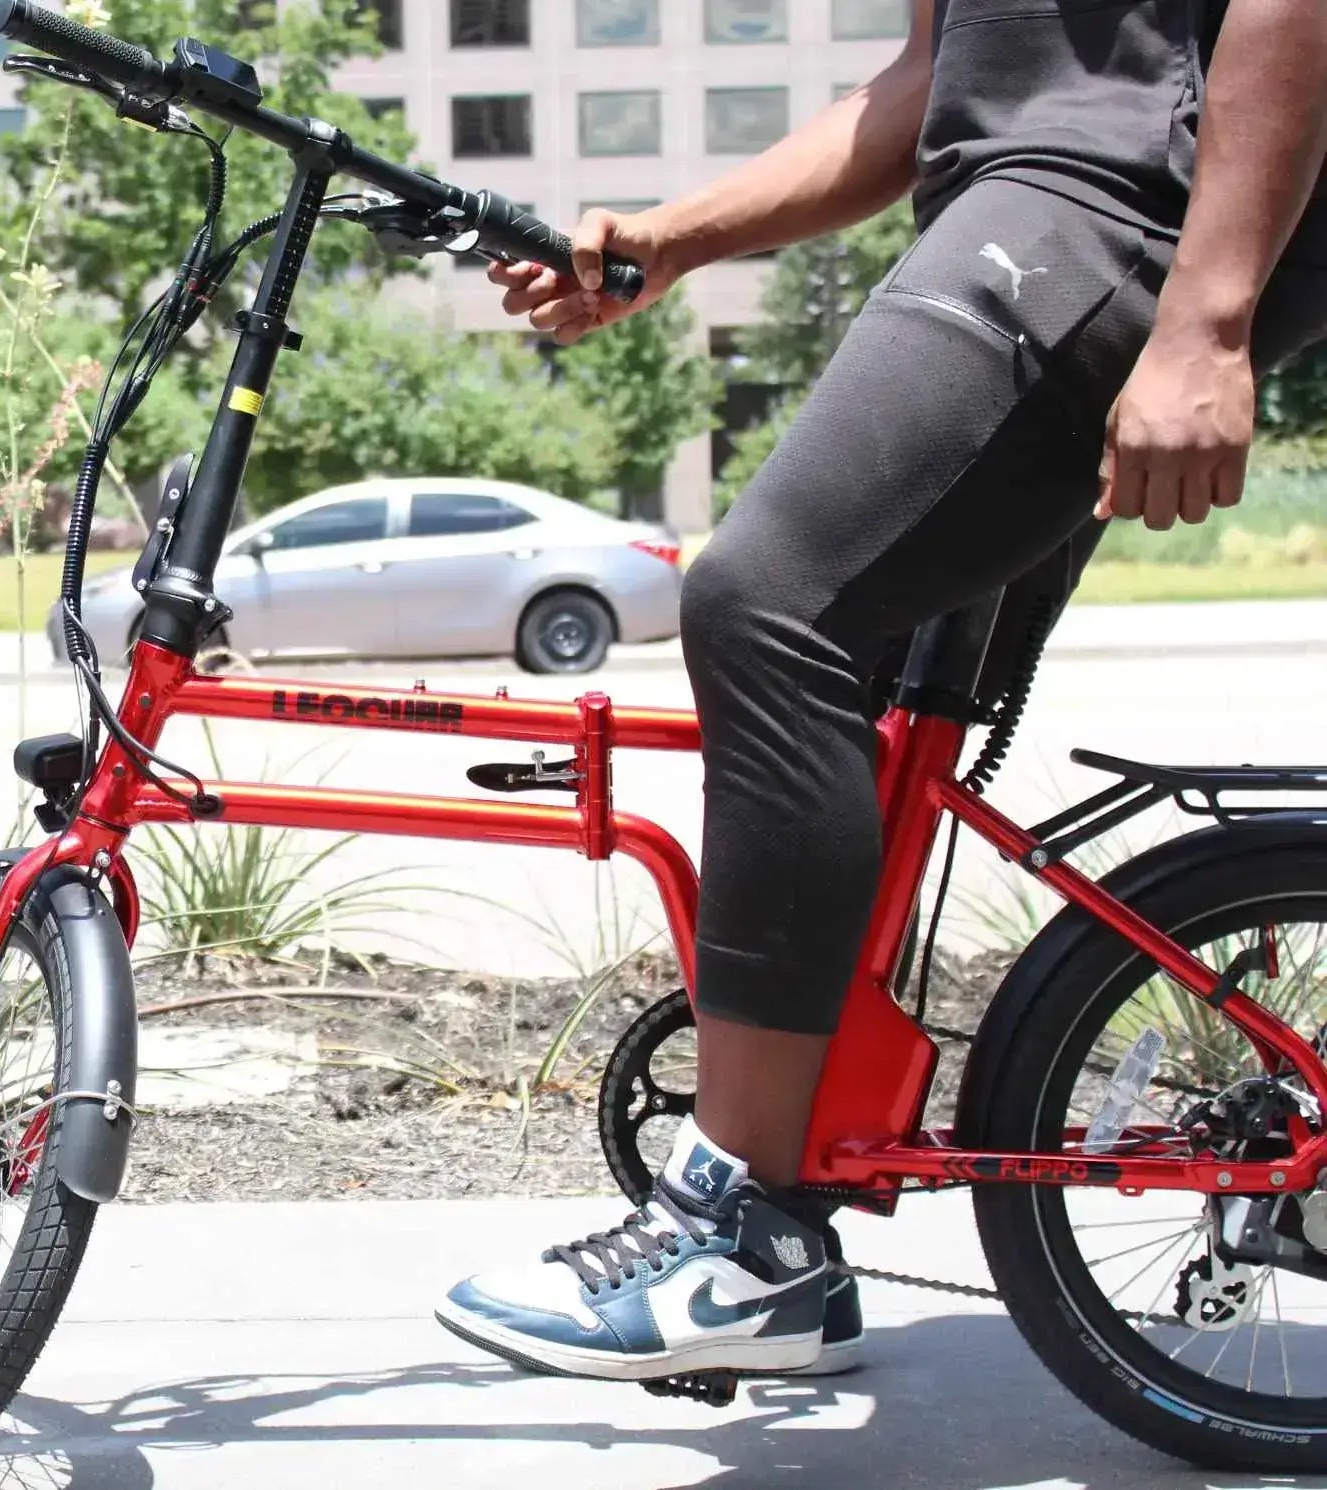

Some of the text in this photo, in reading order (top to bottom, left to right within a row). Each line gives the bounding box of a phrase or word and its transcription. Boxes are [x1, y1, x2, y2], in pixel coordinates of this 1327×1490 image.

[1000, 1158, 1089, 1180] FLIPPO
[688, 1174, 714, 1193] AIR
[1110, 1366, 1139, 1390] BIG
[1208, 1420, 1312, 1444] SCHWALBE
